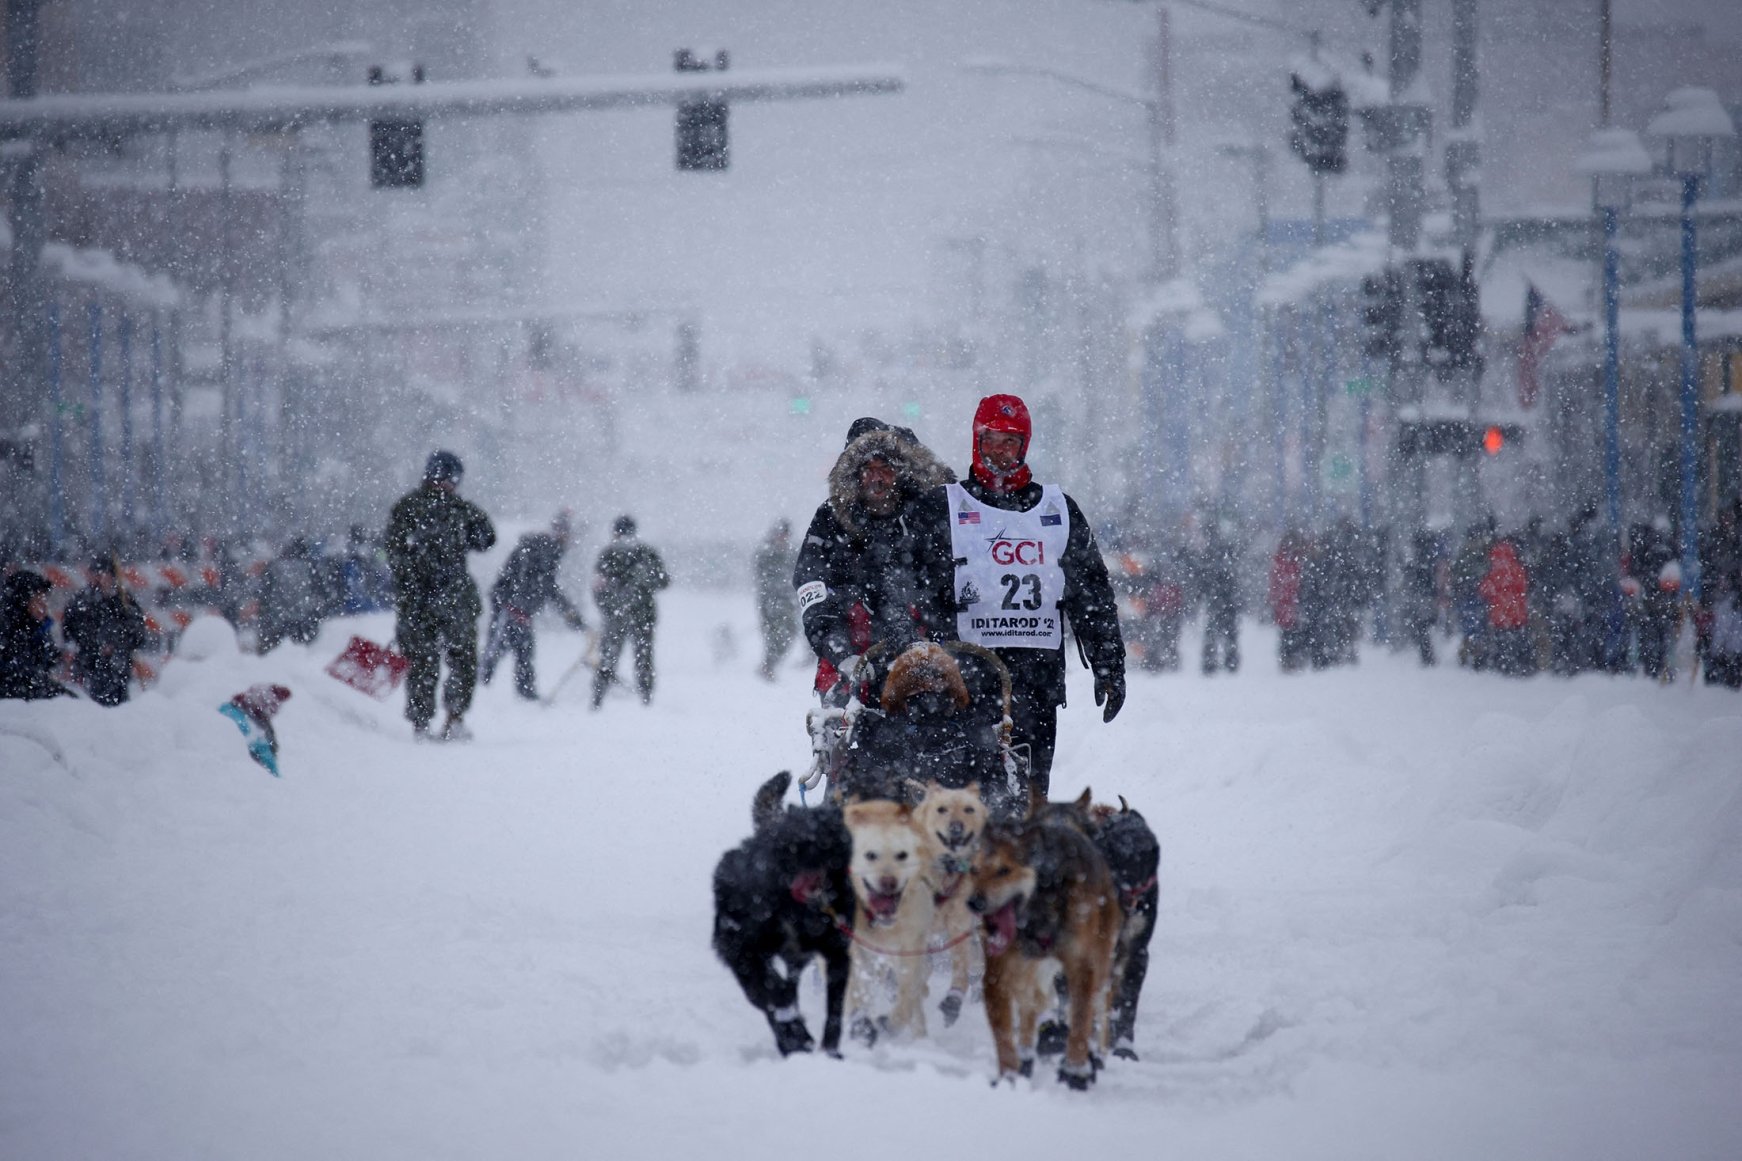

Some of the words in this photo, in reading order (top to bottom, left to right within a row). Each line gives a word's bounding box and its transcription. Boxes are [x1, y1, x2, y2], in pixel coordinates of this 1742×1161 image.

[991, 541, 1045, 565] GCI
[1000, 573, 1042, 611] 23
[971, 617, 1039, 629] IDITAROD
